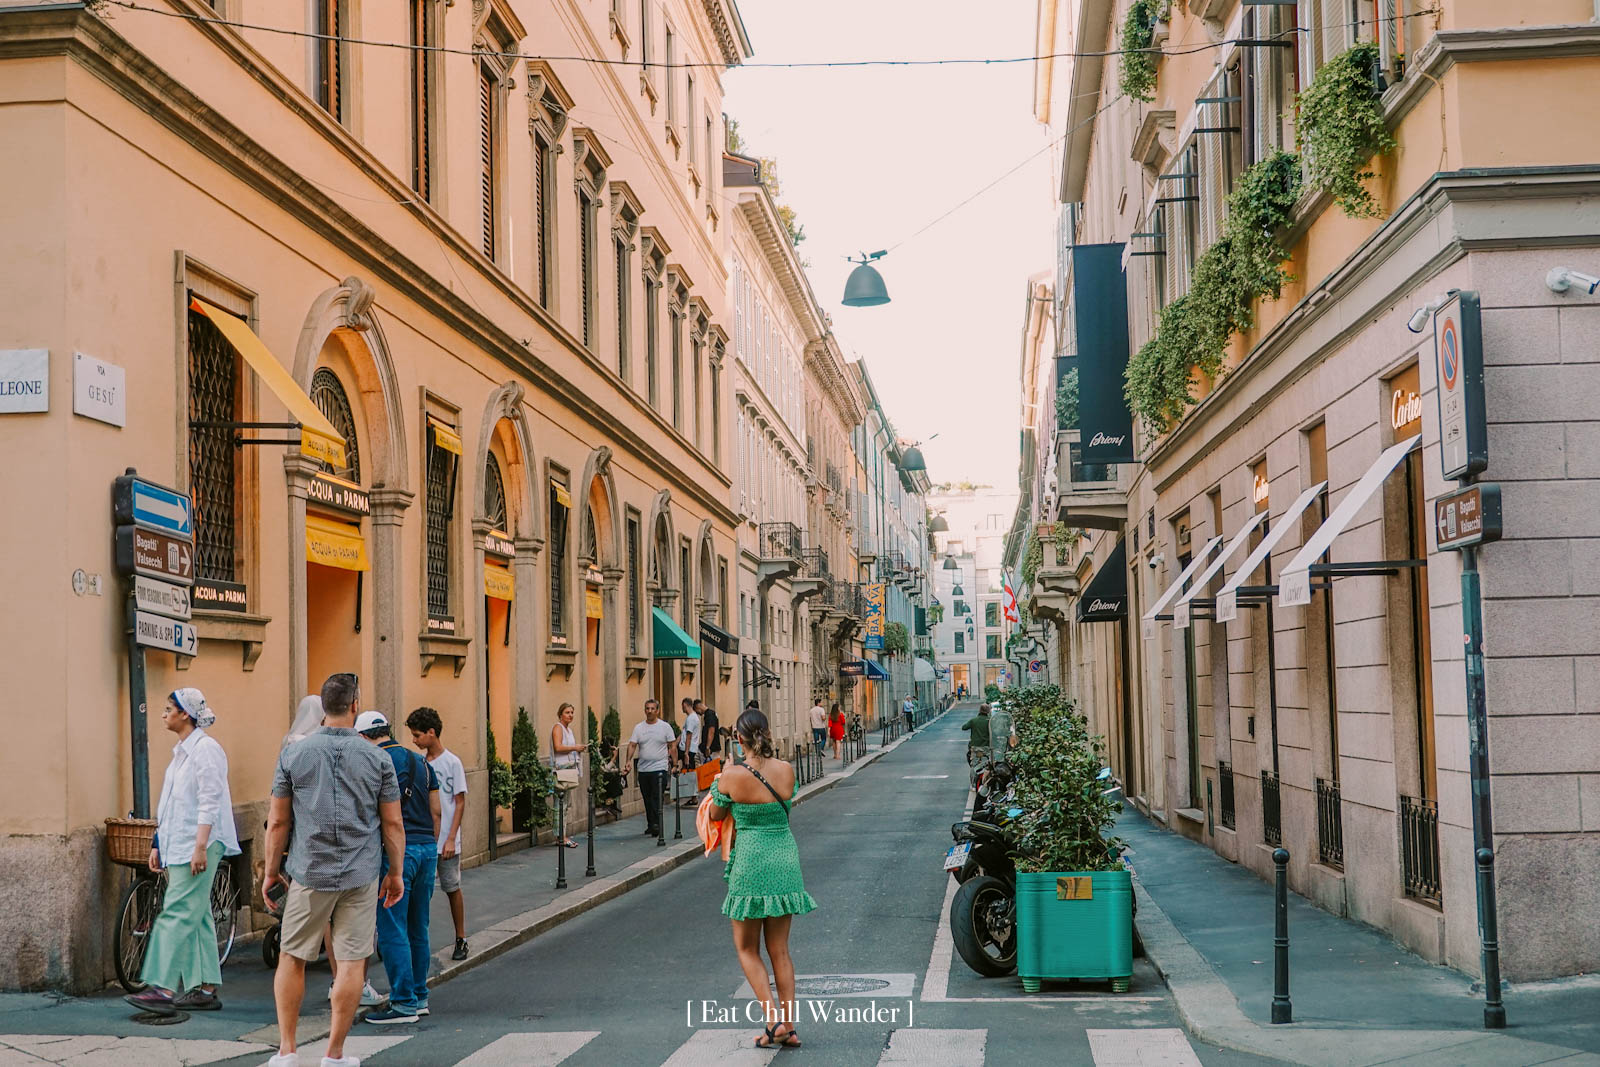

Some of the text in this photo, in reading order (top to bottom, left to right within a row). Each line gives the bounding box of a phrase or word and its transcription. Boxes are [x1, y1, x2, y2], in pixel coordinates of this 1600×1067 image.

[97, 365, 106, 376] VIA
[0, 380, 42, 396] LEONE
[1088, 431, 1126, 448] Brioni
[335, 492, 342, 505] DI
[343, 489, 370, 513] PARMA
[1460, 497, 1476, 515] Bagatti
[1460, 515, 1481, 534] Valsecchi
[136, 534, 158, 551] Bagatti
[136, 551, 163, 569] Valsecchi
[195, 586, 217, 600] ACQUA
[225, 590, 246, 604] PARMA
[1087, 598, 1121, 613] Brioni
[138, 620, 158, 640] PARKING
[164, 626, 173, 642] SPA
